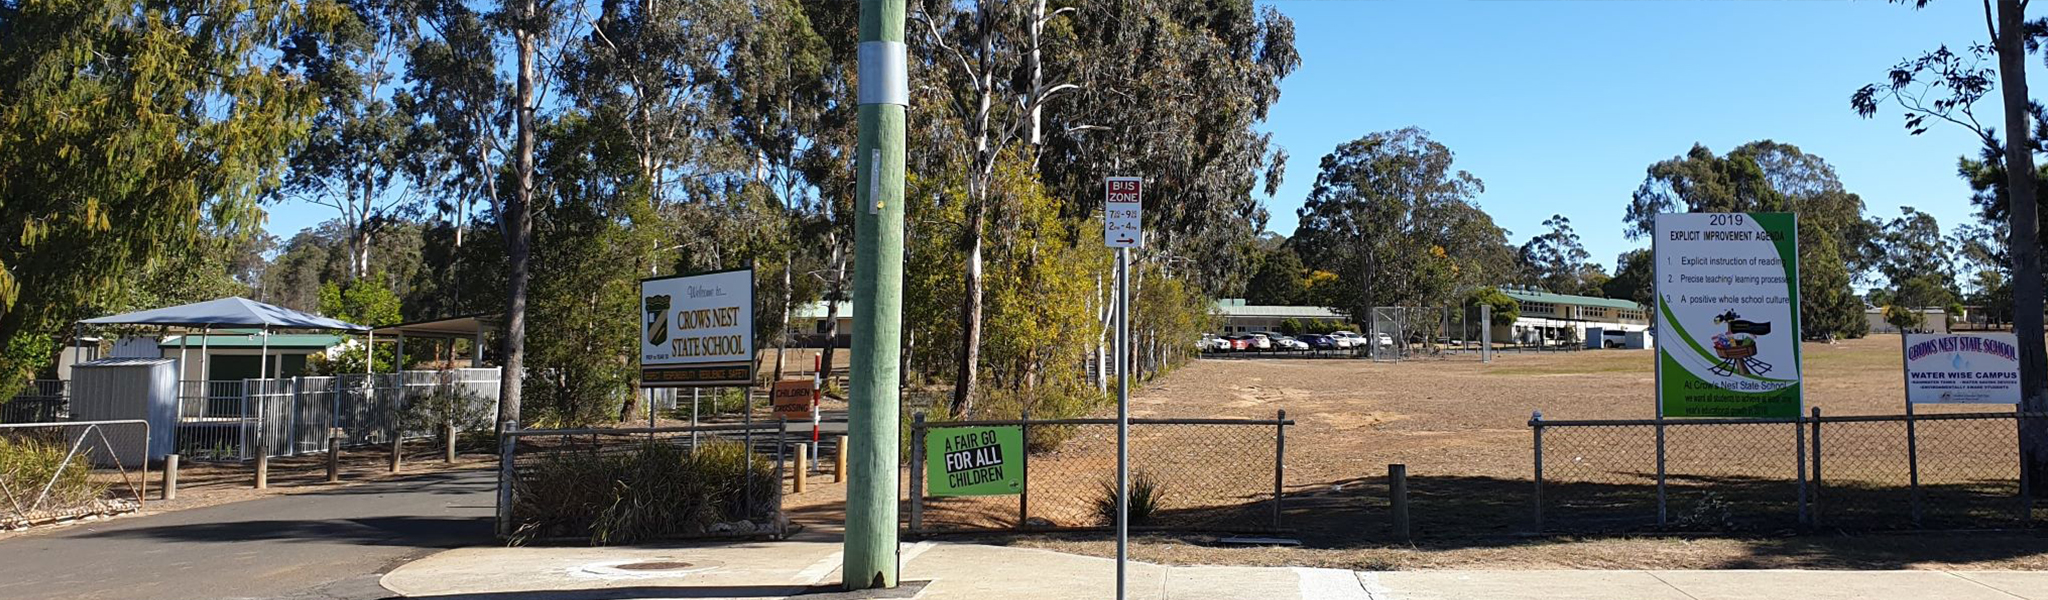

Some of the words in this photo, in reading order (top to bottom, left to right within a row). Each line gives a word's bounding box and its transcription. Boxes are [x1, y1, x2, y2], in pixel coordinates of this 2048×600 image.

[1112, 181, 1135, 191] BUS
[1109, 193, 1138, 202] ZONE
[1709, 214, 1744, 226] 2019
[1670, 231, 1700, 241] EXPLICIT
[1703, 231, 1753, 241] IMPROVEMENT
[1755, 231, 1785, 241] AGENDA
[1681, 256, 1708, 267] Explicit
[1709, 256, 1748, 266] instruction
[1749, 256, 1757, 266] of
[1758, 257, 1786, 268] reading
[1680, 274, 1704, 283] Precise
[1734, 274, 1760, 285] learning
[687, 285, 714, 298] Welcome
[1680, 294, 1687, 304] A
[1690, 294, 1717, 305] positive
[1718, 294, 1740, 304] whole
[1741, 294, 1764, 304] school
[1765, 294, 1790, 304] culture
[677, 308, 711, 330] CROWS
[712, 306, 740, 328] NEST
[672, 337, 700, 357] STATE
[702, 335, 745, 356] SCHOOL
[1908, 338, 1938, 361] CROWS
[1938, 336, 1959, 353] NEST
[1959, 336, 1983, 353] STATE
[1983, 338, 2018, 361] SCHOOL
[728, 368, 749, 378] SAFETY
[1911, 371, 1945, 379] WATER
[1947, 371, 1972, 379] WISE
[1975, 371, 2017, 379] CAMPUS
[1685, 380, 1693, 390] At
[1694, 380, 1719, 390] Crow's
[1720, 380, 1738, 390] Nest
[1739, 380, 1759, 390] State
[776, 388, 810, 397] CHILDREN
[774, 403, 809, 412] CROSSING
[945, 437, 953, 452] A
[954, 433, 979, 450] FAIR
[981, 430, 997, 445] GO
[946, 451, 973, 472] FOR
[976, 446, 1001, 467] ALL
[949, 466, 1004, 489] CHILDREN
